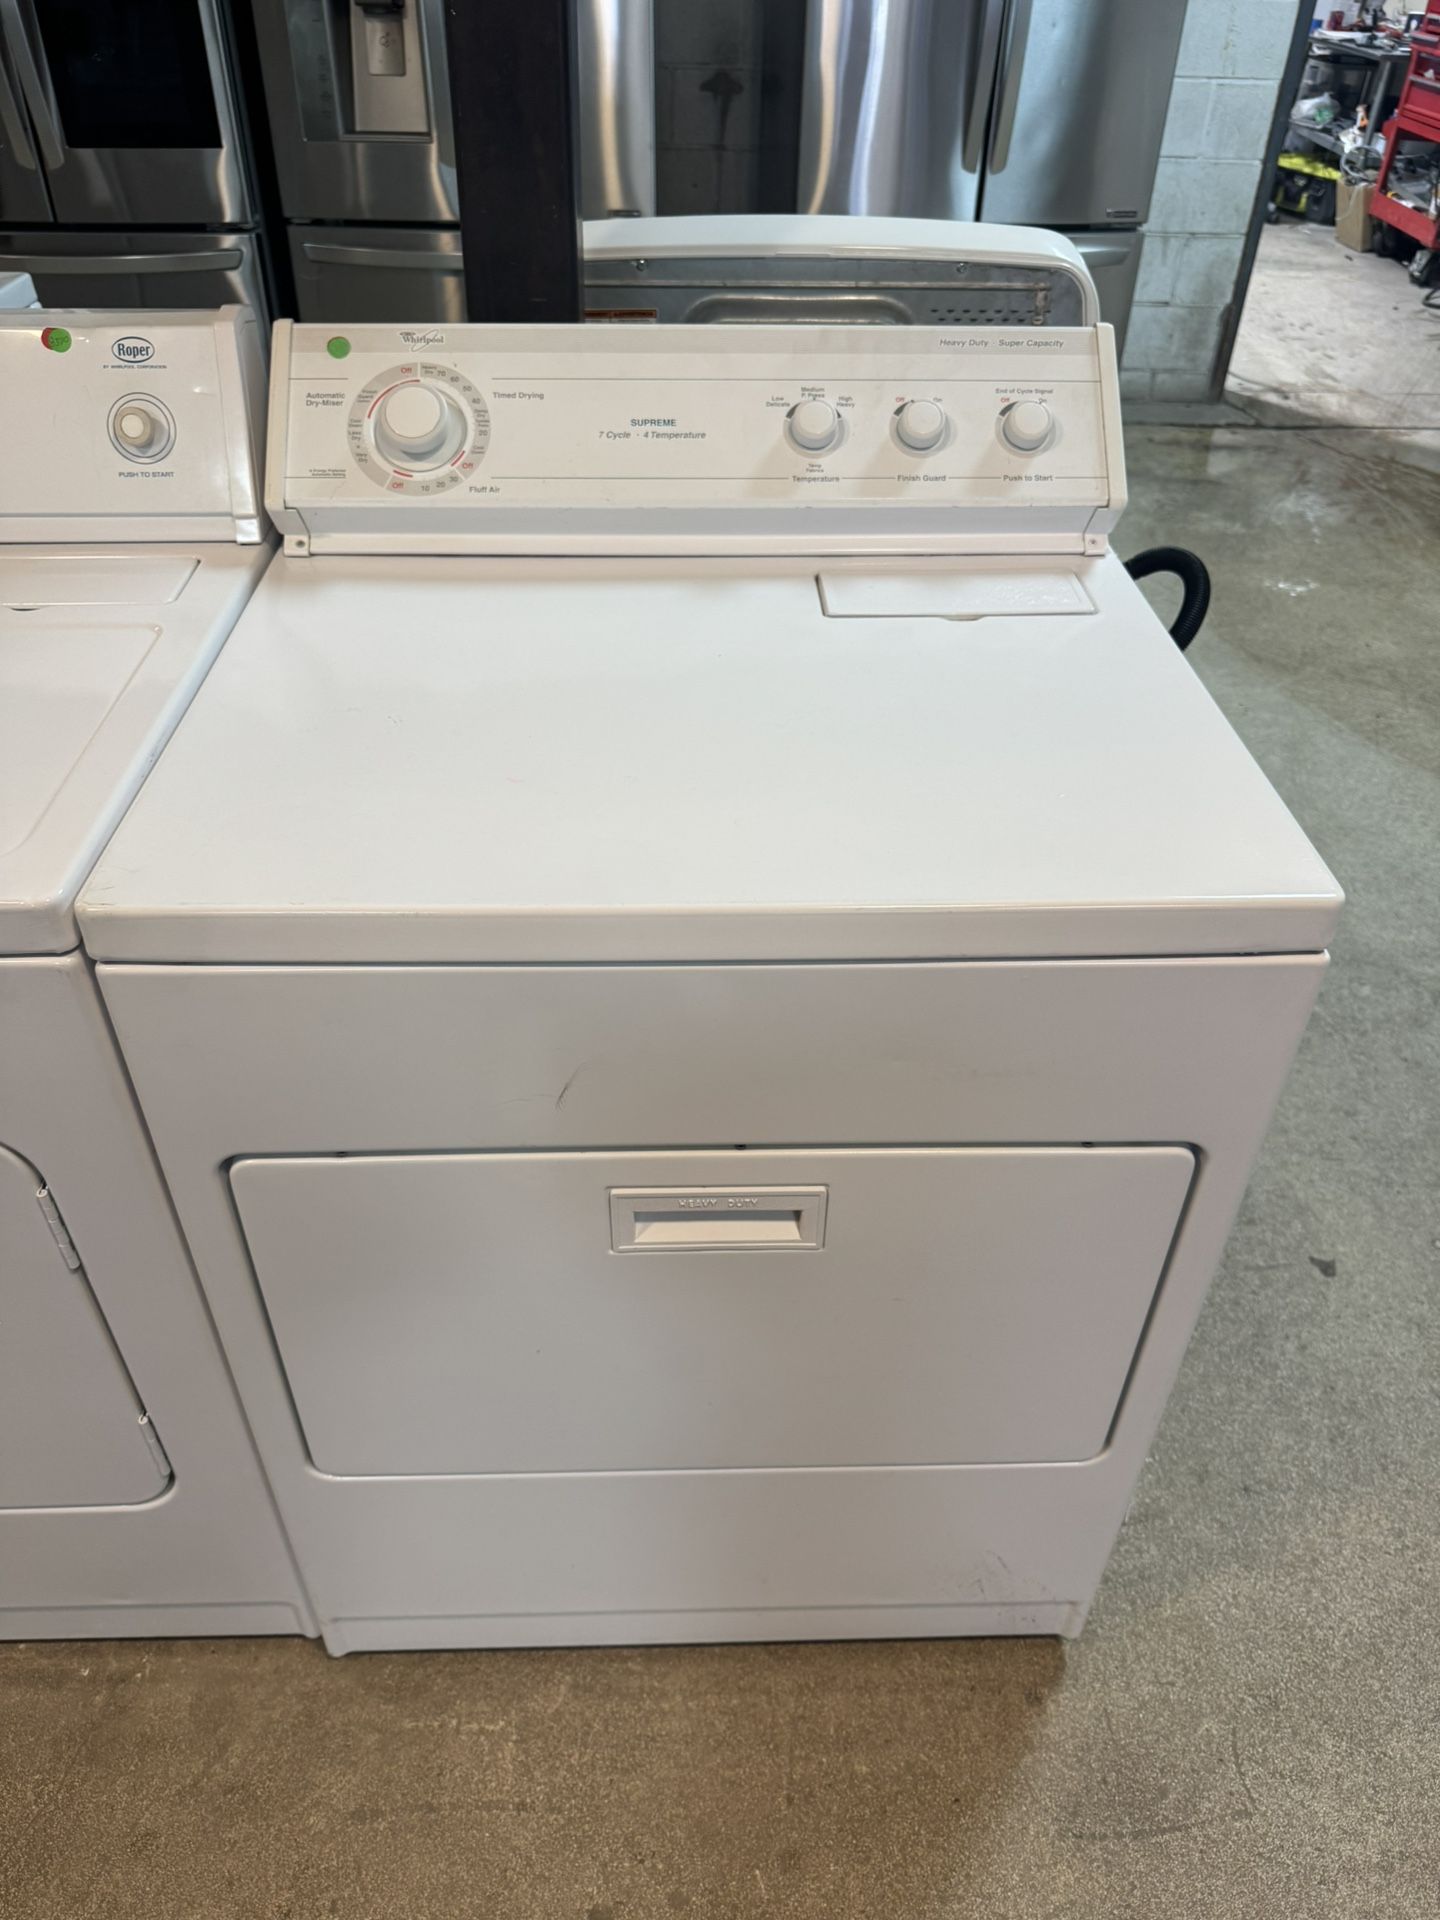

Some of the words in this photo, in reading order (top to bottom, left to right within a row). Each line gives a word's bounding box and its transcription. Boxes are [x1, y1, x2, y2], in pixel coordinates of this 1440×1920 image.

[400, 334, 445, 347] Whirlpool
[939, 339, 966, 348] Heavy
[969, 339, 989, 348] Duty
[998, 339, 1024, 348] Super
[1026, 339, 1064, 348] Capacity
[117, 343, 151, 359] Roper
[492, 391, 516, 399] Timed
[518, 391, 544, 400] Drying
[306, 400, 343, 408] Dry-Miser
[630, 418, 677, 427] SUPREME
[598, 431, 605, 439] 7
[606, 431, 631, 440] Cycle
[643, 431, 649, 439] 4
[651, 431, 706, 440] Temperature
[792, 475, 840, 483] Temperature
[897, 474, 921, 482] Finish
[922, 474, 946, 482] Guard
[1003, 474, 1023, 482] Push
[1034, 474, 1053, 482] Start
[678, 1198, 718, 1208] HEAVY
[728, 1198, 758, 1208] DUTY
